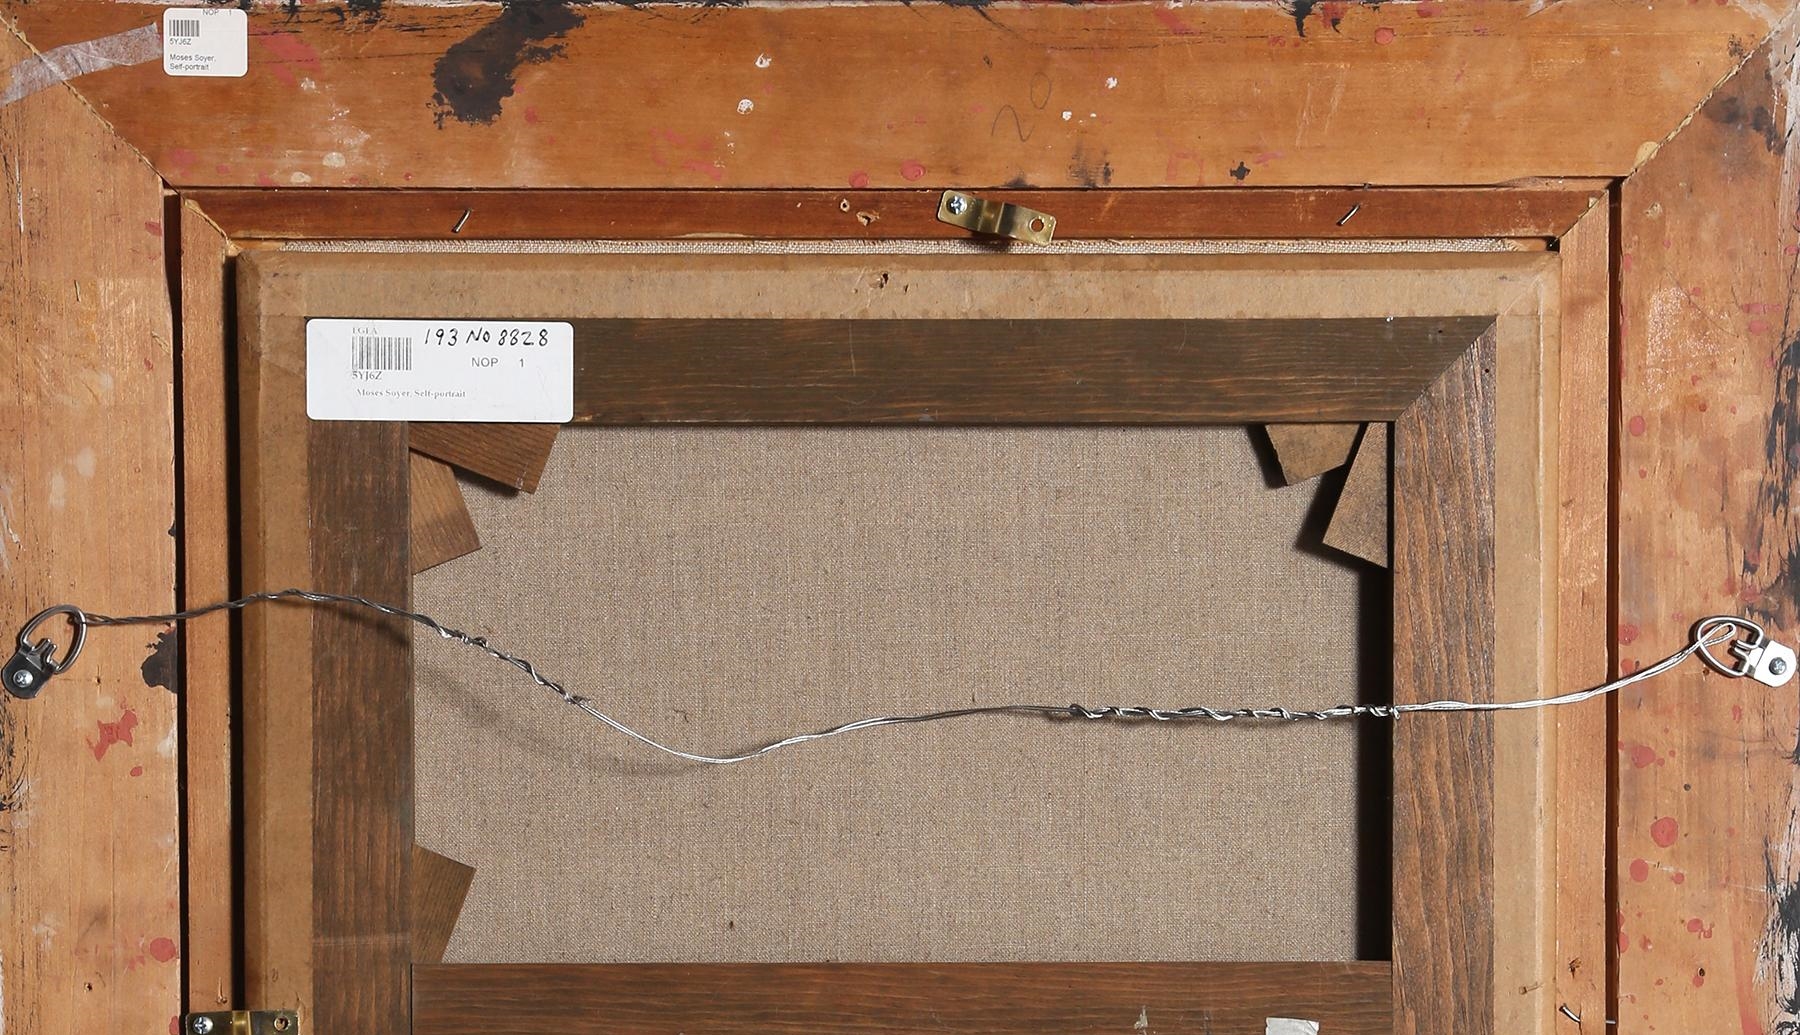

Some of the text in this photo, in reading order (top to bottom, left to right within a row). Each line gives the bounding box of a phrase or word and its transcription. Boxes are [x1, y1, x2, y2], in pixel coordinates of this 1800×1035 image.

[169, 37, 192, 46] 5YJ6Z
[169, 53, 193, 61] Moses
[169, 62, 209, 71] Self-portrait
[424, 327, 458, 346] 193
[471, 356, 525, 368] NOP 1
[352, 370, 382, 382] 5YJ6Z
[357, 388, 384, 397] Moses
[414, 389, 466, 400] Self-portrait
